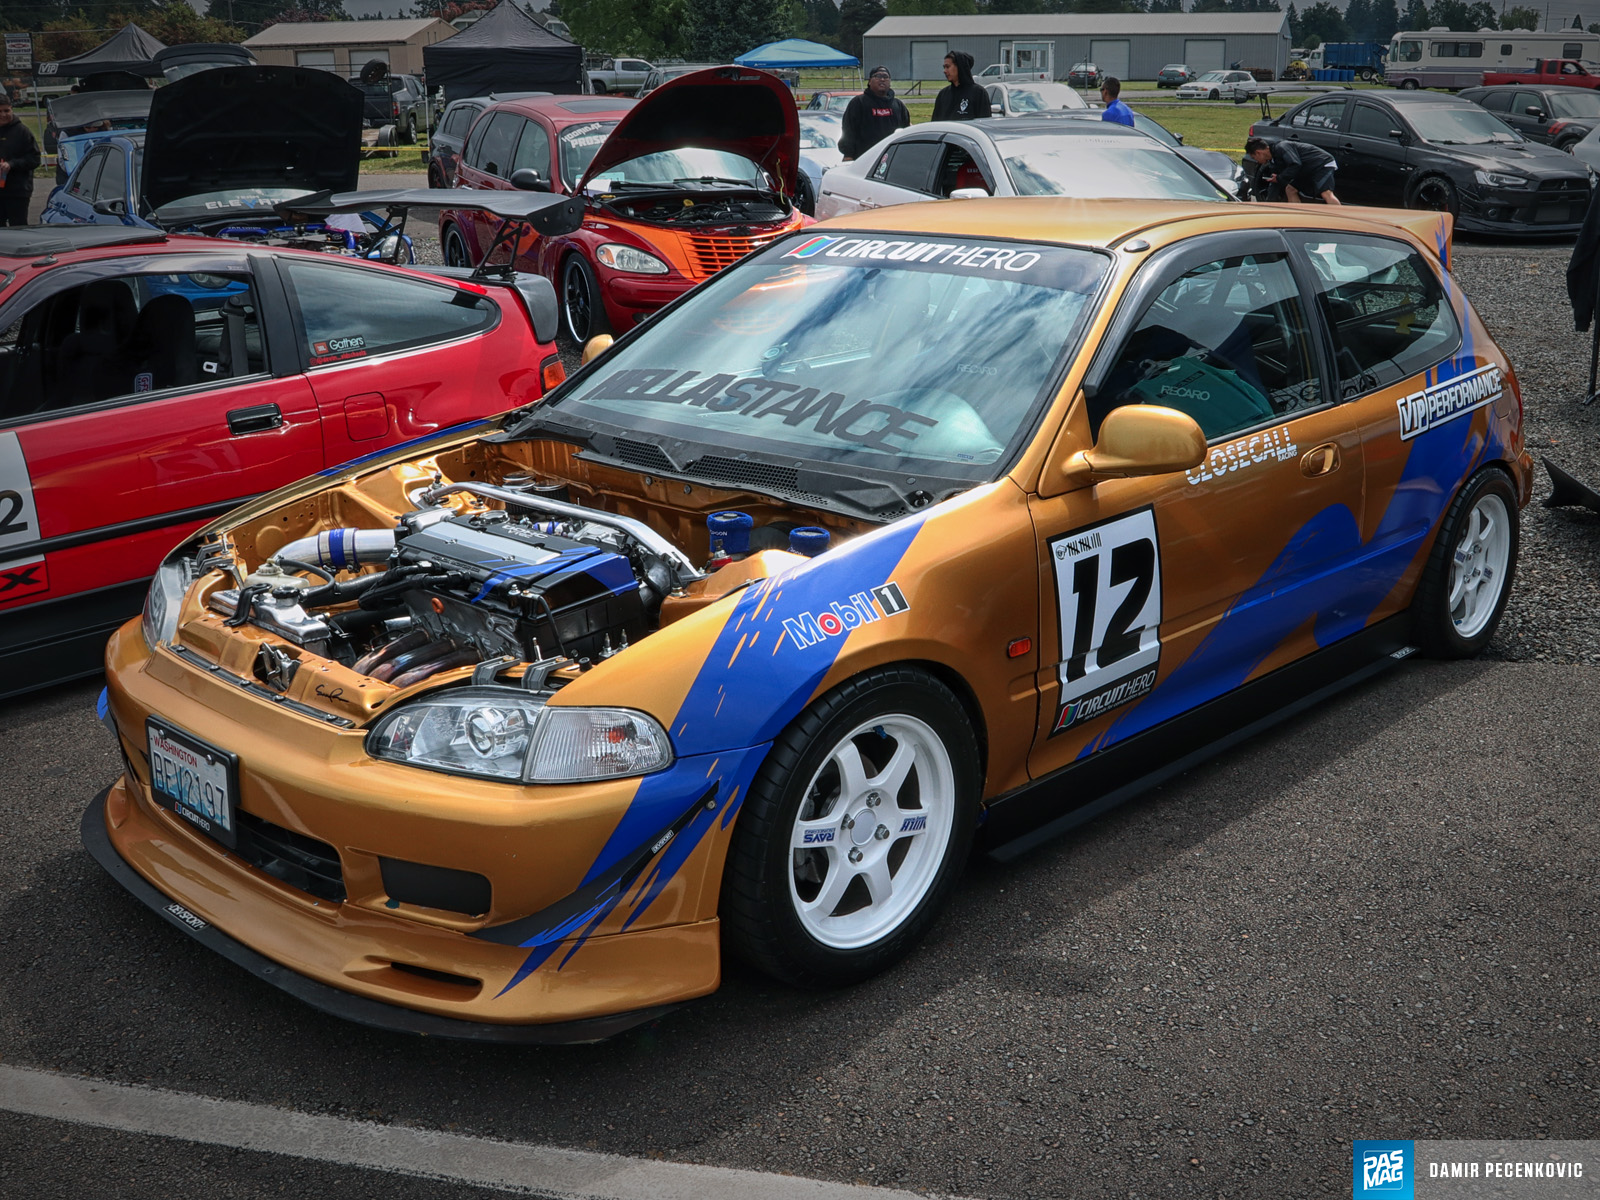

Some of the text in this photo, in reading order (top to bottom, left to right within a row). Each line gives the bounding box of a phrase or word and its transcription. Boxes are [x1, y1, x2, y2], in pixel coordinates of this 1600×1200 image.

[39, 62, 59, 74] VIP
[570, 134, 610, 148] PROSP
[329, 337, 364, 351] Gathers
[957, 363, 998, 376] RECARO
[1160, 385, 1211, 401] RECARO
[1398, 368, 1502, 439] VIP PERFORMANCE
[579, 369, 939, 451] HELLASTANCE
[1277, 450, 1298, 462] RACING
[782, 591, 881, 650] Mobil
[1067, 537, 1155, 682] 12
[1077, 670, 1156, 719] CIRCUITHERO
[153, 735, 198, 768] WASHINGTON
[152, 749, 225, 827] BEV2197
[803, 832, 835, 844] RAYS
